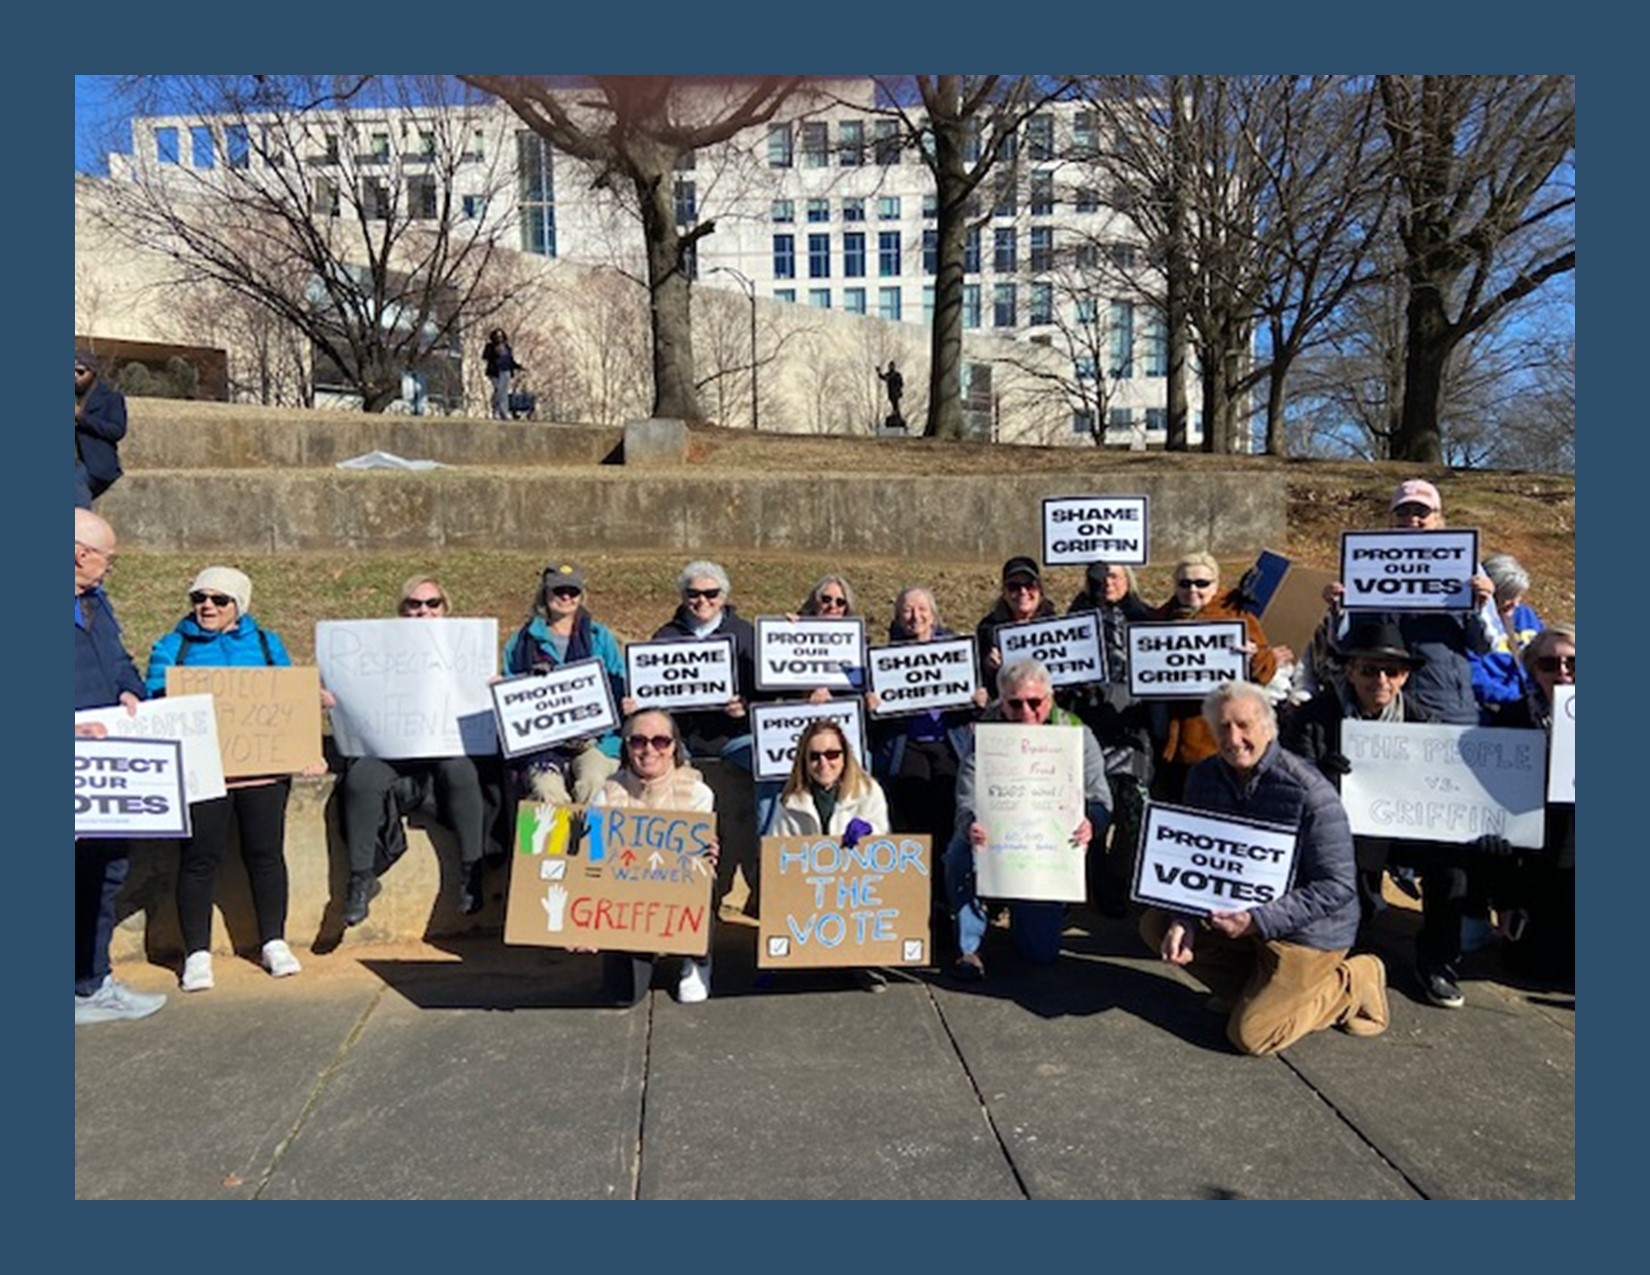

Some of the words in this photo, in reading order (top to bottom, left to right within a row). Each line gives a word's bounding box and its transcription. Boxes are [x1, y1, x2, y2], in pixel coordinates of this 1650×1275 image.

[1052, 507, 1139, 523] SHAME
[1077, 524, 1113, 536] ON
[1051, 539, 1138, 553] GRIFFIN
[1352, 547, 1466, 561] PROTECT
[1384, 563, 1431, 574] OUR
[1353, 578, 1464, 595] VOTES
[767, 632, 855, 645] PROTECT
[1006, 625, 1092, 651] SHAME
[1137, 633, 1236, 652] SHAME
[635, 649, 725, 668] SHAME
[793, 647, 829, 657] OUR
[877, 649, 968, 672] SHAME
[1032, 646, 1067, 660] ON
[1166, 653, 1206, 667] ON
[662, 667, 699, 681] ON
[1045, 656, 1095, 674] FFIN
[905, 669, 942, 683] ON
[1138, 669, 1236, 683] GRIFFIN
[503, 675, 597, 706] PROTECT
[636, 681, 727, 698] GRIFFIN
[880, 681, 970, 702] GRIFFIN
[534, 695, 573, 711] OUR
[511, 702, 604, 737] VOTES
[1350, 733, 1409, 760] THE
[1423, 737, 1532, 771] PEOPLE
[1369, 799, 1507, 836] GRIFFIN
[608, 809, 712, 856] RIGGS
[1156, 825, 1286, 864] PROTECT
[779, 839, 929, 876] HONOR
[1191, 853, 1244, 875] OUR
[806, 874, 885, 909] THE
[1153, 862, 1276, 904] VOTES
[569, 896, 705, 938] GRIFFIN
[787, 909, 899, 948] VOTE
